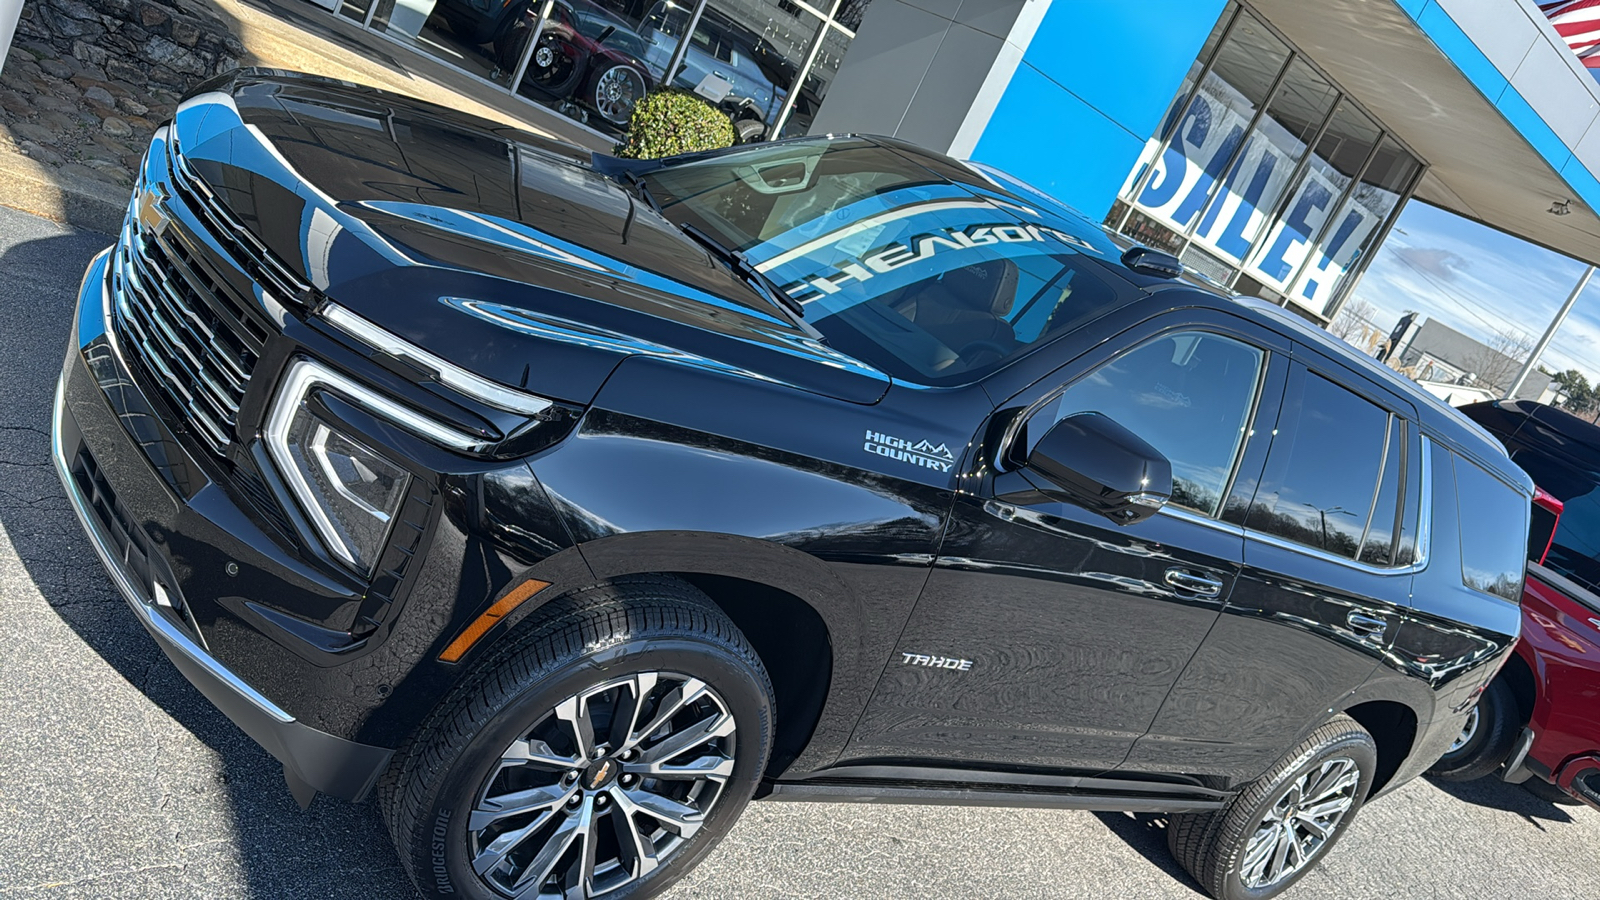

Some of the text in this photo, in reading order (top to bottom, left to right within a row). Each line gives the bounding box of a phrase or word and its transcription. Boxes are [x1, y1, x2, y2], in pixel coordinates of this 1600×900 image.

[1137, 92, 1364, 300] SALE!
[865, 429, 912, 451] HIGH
[863, 441, 952, 473] COUNTRY
[902, 652, 973, 671] TAHOE
[431, 808, 454, 894] BRIDGESTONE
